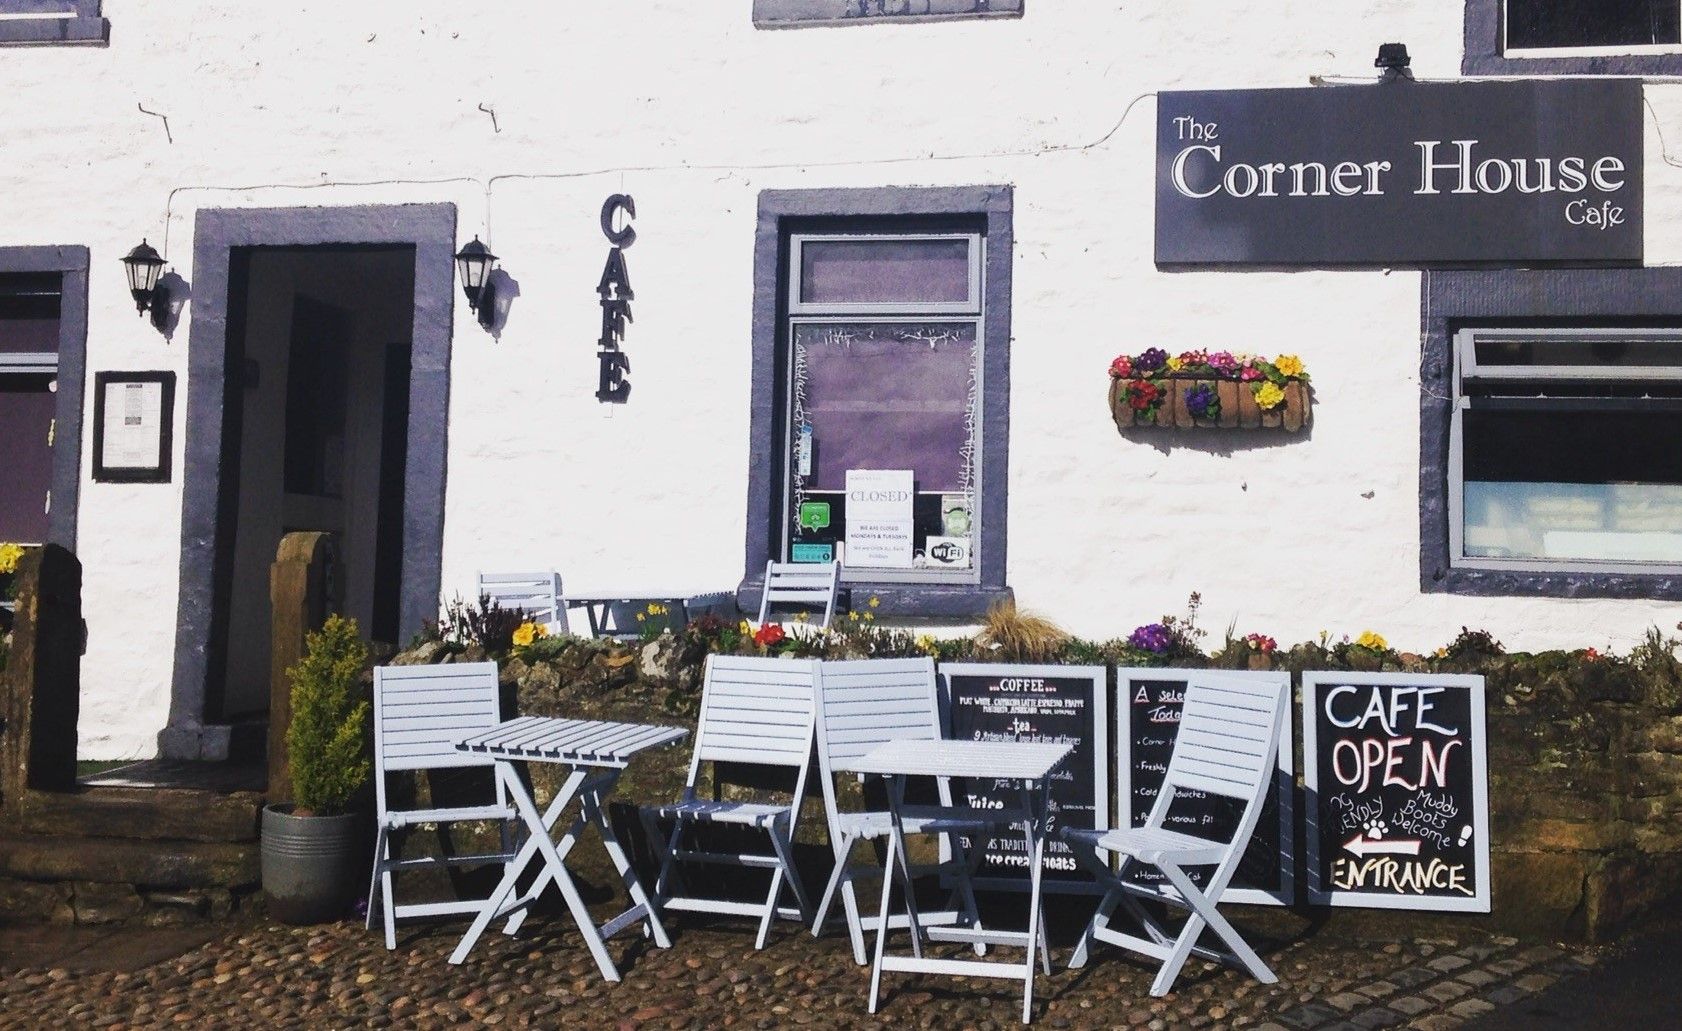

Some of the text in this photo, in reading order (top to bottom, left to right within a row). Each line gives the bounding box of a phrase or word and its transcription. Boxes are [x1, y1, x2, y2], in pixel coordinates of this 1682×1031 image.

[1173, 116, 1219, 141] The
[1171, 140, 1625, 198] Corner House
[1564, 200, 1625, 230] Cafe
[595, 193, 637, 404] CAFE
[851, 490, 908, 502] CLOSED
[1134, 685, 1150, 702] A
[1148, 705, 1182, 722] Toda
[1325, 686, 1458, 737] CAFE
[1333, 737, 1462, 794] OPEN
[1140, 787, 1157, 796] Cold
[1416, 790, 1458, 818] Muddy
[1400, 799, 1447, 829] Boots
[1391, 812, 1451, 850] Welcome
[1330, 857, 1474, 895] ENTRANCE
